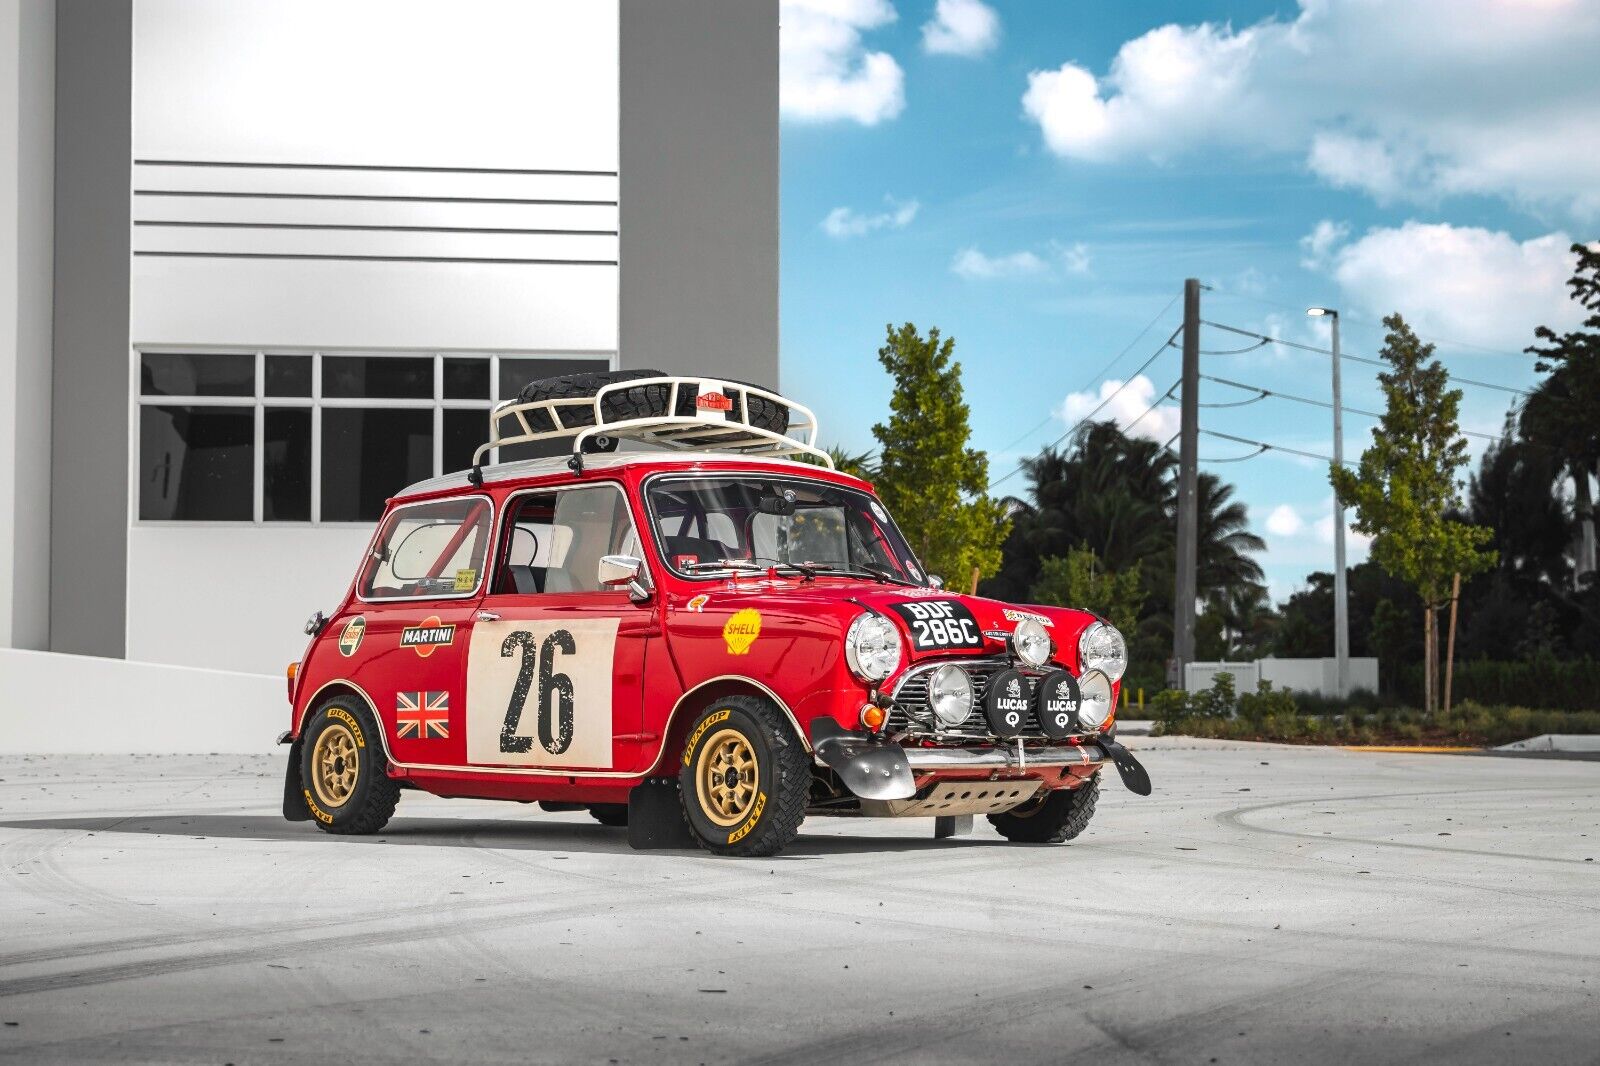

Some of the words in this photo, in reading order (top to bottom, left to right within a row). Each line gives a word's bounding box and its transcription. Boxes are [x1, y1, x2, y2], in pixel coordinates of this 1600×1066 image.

[901, 601, 953, 619] BDF
[403, 628, 451, 643] MARTINI
[728, 623, 755, 635] SHELL
[912, 619, 979, 646] 286C
[500, 629, 576, 755] 26
[997, 698, 1028, 711] LUCAS
[1047, 700, 1077, 711] LUCAS
[329, 708, 364, 743] DUNLOP
[1005, 711, 1020, 728] Q
[1055, 713, 1069, 728] Q
[686, 710, 728, 760] DUNLOP
[732, 796, 765, 840] RALLY
